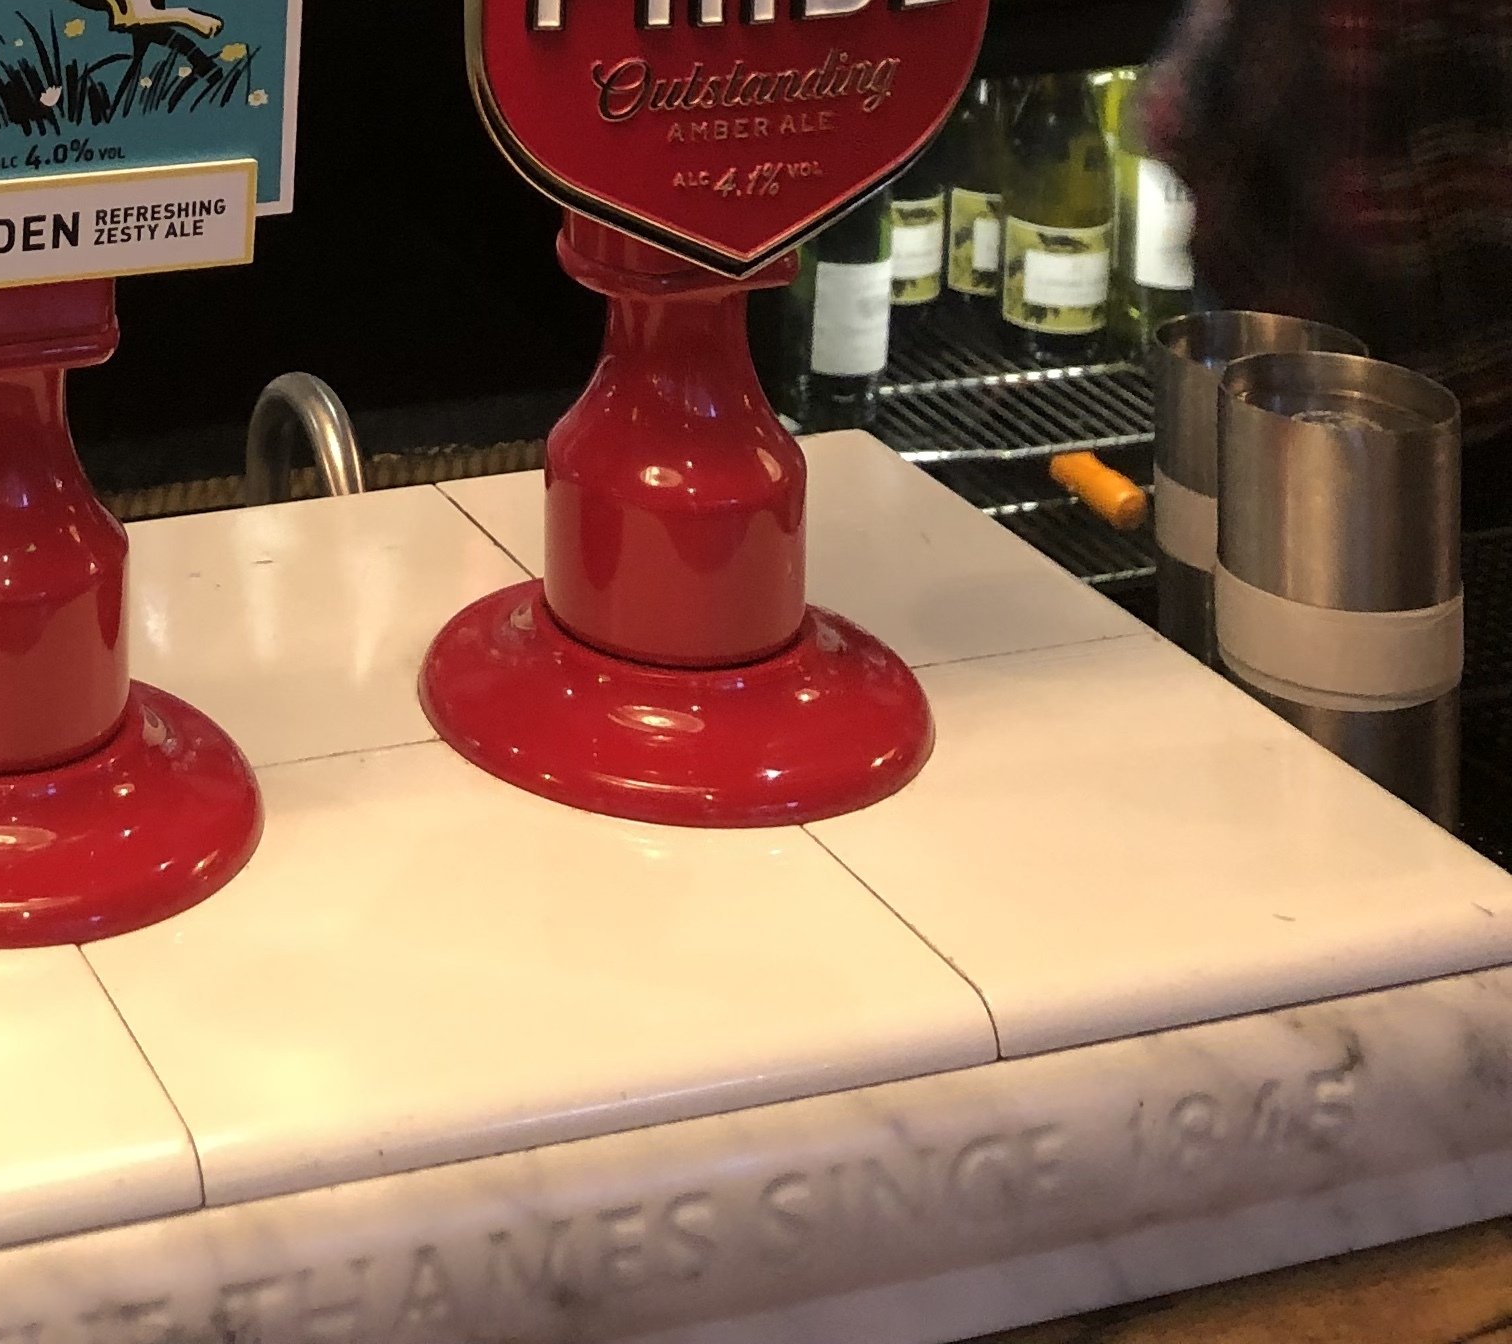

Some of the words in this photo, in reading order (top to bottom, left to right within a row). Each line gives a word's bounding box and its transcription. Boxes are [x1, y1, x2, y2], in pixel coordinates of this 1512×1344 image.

[591, 48, 901, 122] Outstanding
[666, 116, 771, 145] AMBER
[779, 111, 835, 134] ALE
[24, 138, 96, 170] 4.0%
[98, 146, 127, 162] VOL
[672, 170, 710, 188] ALC
[712, 161, 785, 198] 4.1%
[787, 160, 825, 177] VOL
[94, 197, 228, 226] REFRESHING
[93, 222, 161, 247] ZESTY
[163, 217, 205, 240] ALE
[214, 1188, 718, 1344] THAMES
[758, 1123, 1070, 1256] SINCE
